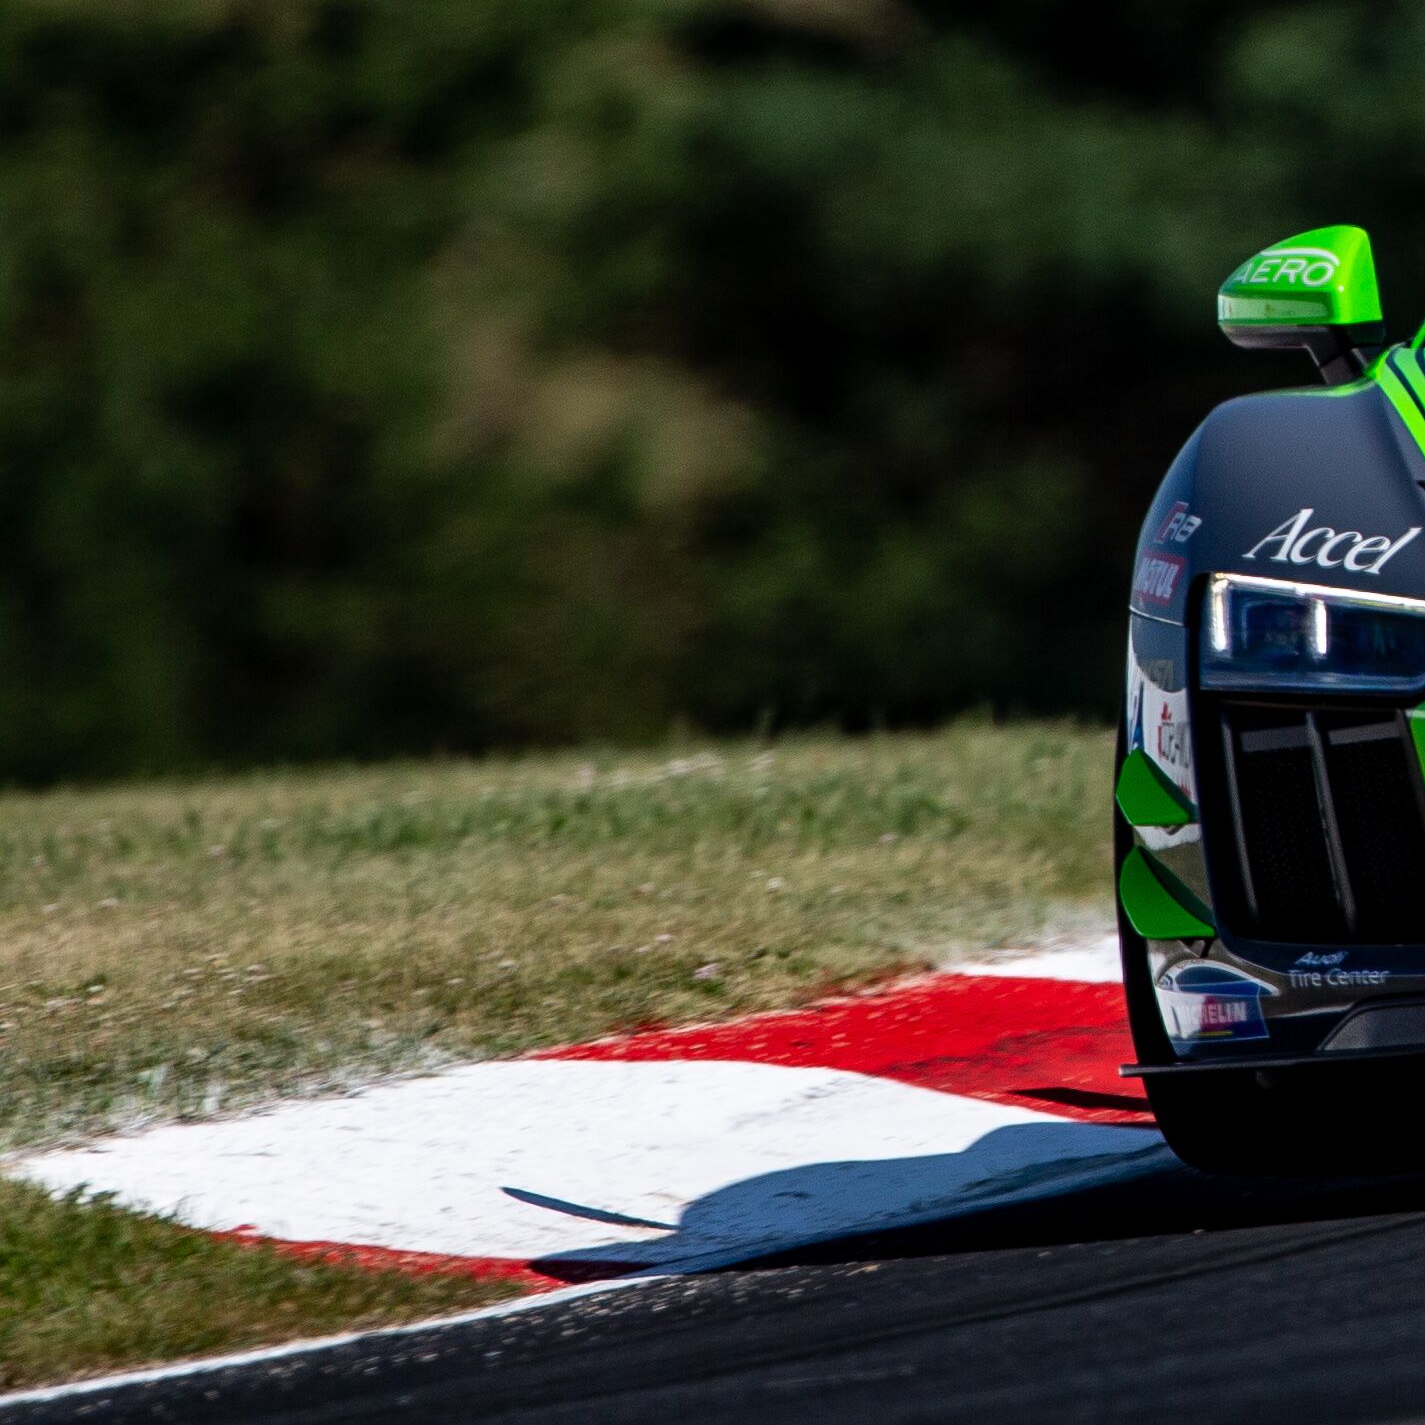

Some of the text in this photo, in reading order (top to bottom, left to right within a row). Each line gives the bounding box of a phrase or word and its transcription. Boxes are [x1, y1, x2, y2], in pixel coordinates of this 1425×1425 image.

[1234, 258, 1336, 287] AERO
[1242, 508, 1424, 575] Accel
[1288, 968, 1389, 988] Tire Center
